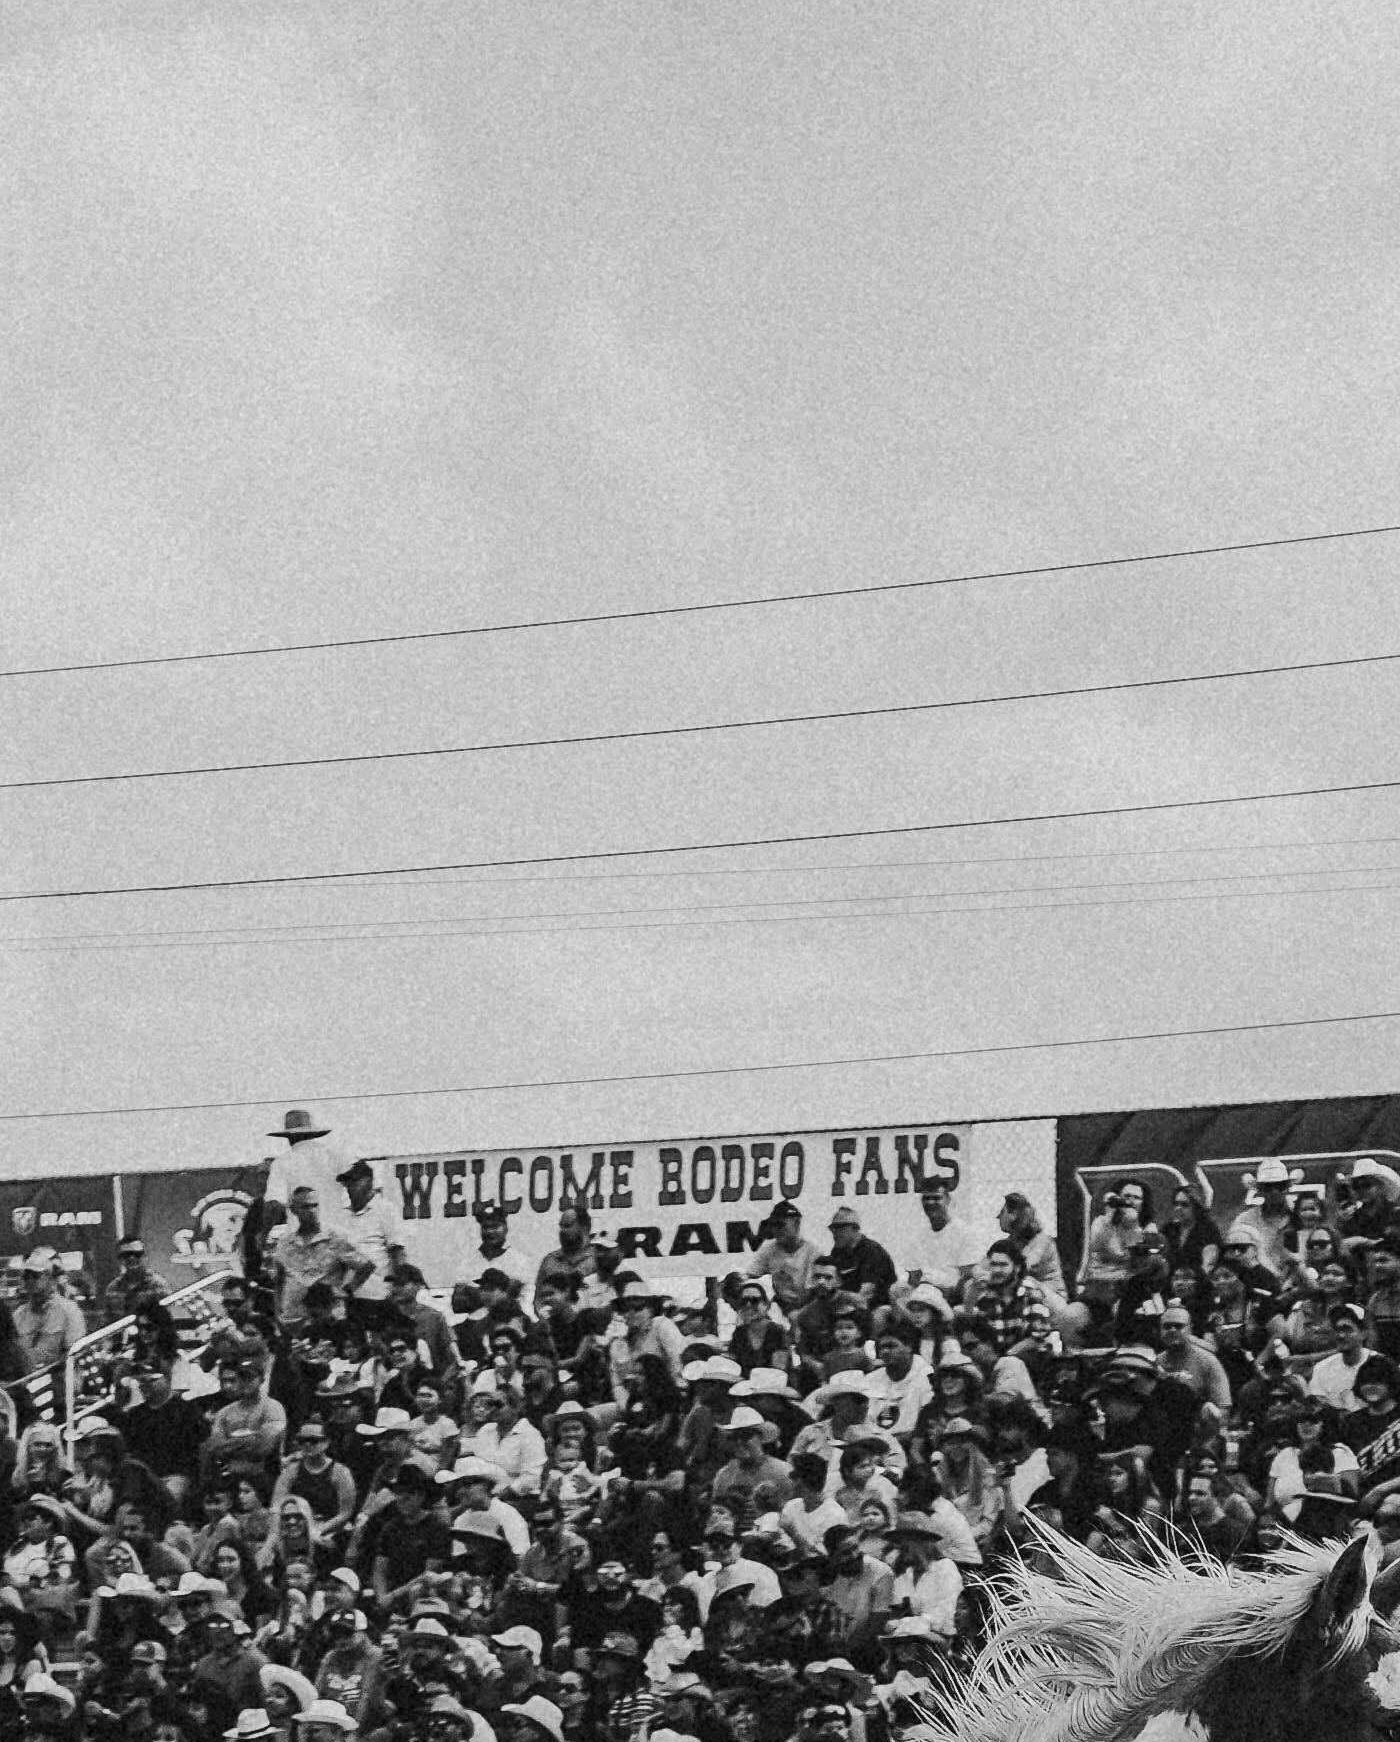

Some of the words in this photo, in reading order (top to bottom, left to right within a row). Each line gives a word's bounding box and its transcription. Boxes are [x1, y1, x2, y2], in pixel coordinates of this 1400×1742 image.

[395, 1150, 634, 1220] WELCOME
[658, 1140, 806, 1206] RODEO
[831, 1132, 960, 1196] FANS
